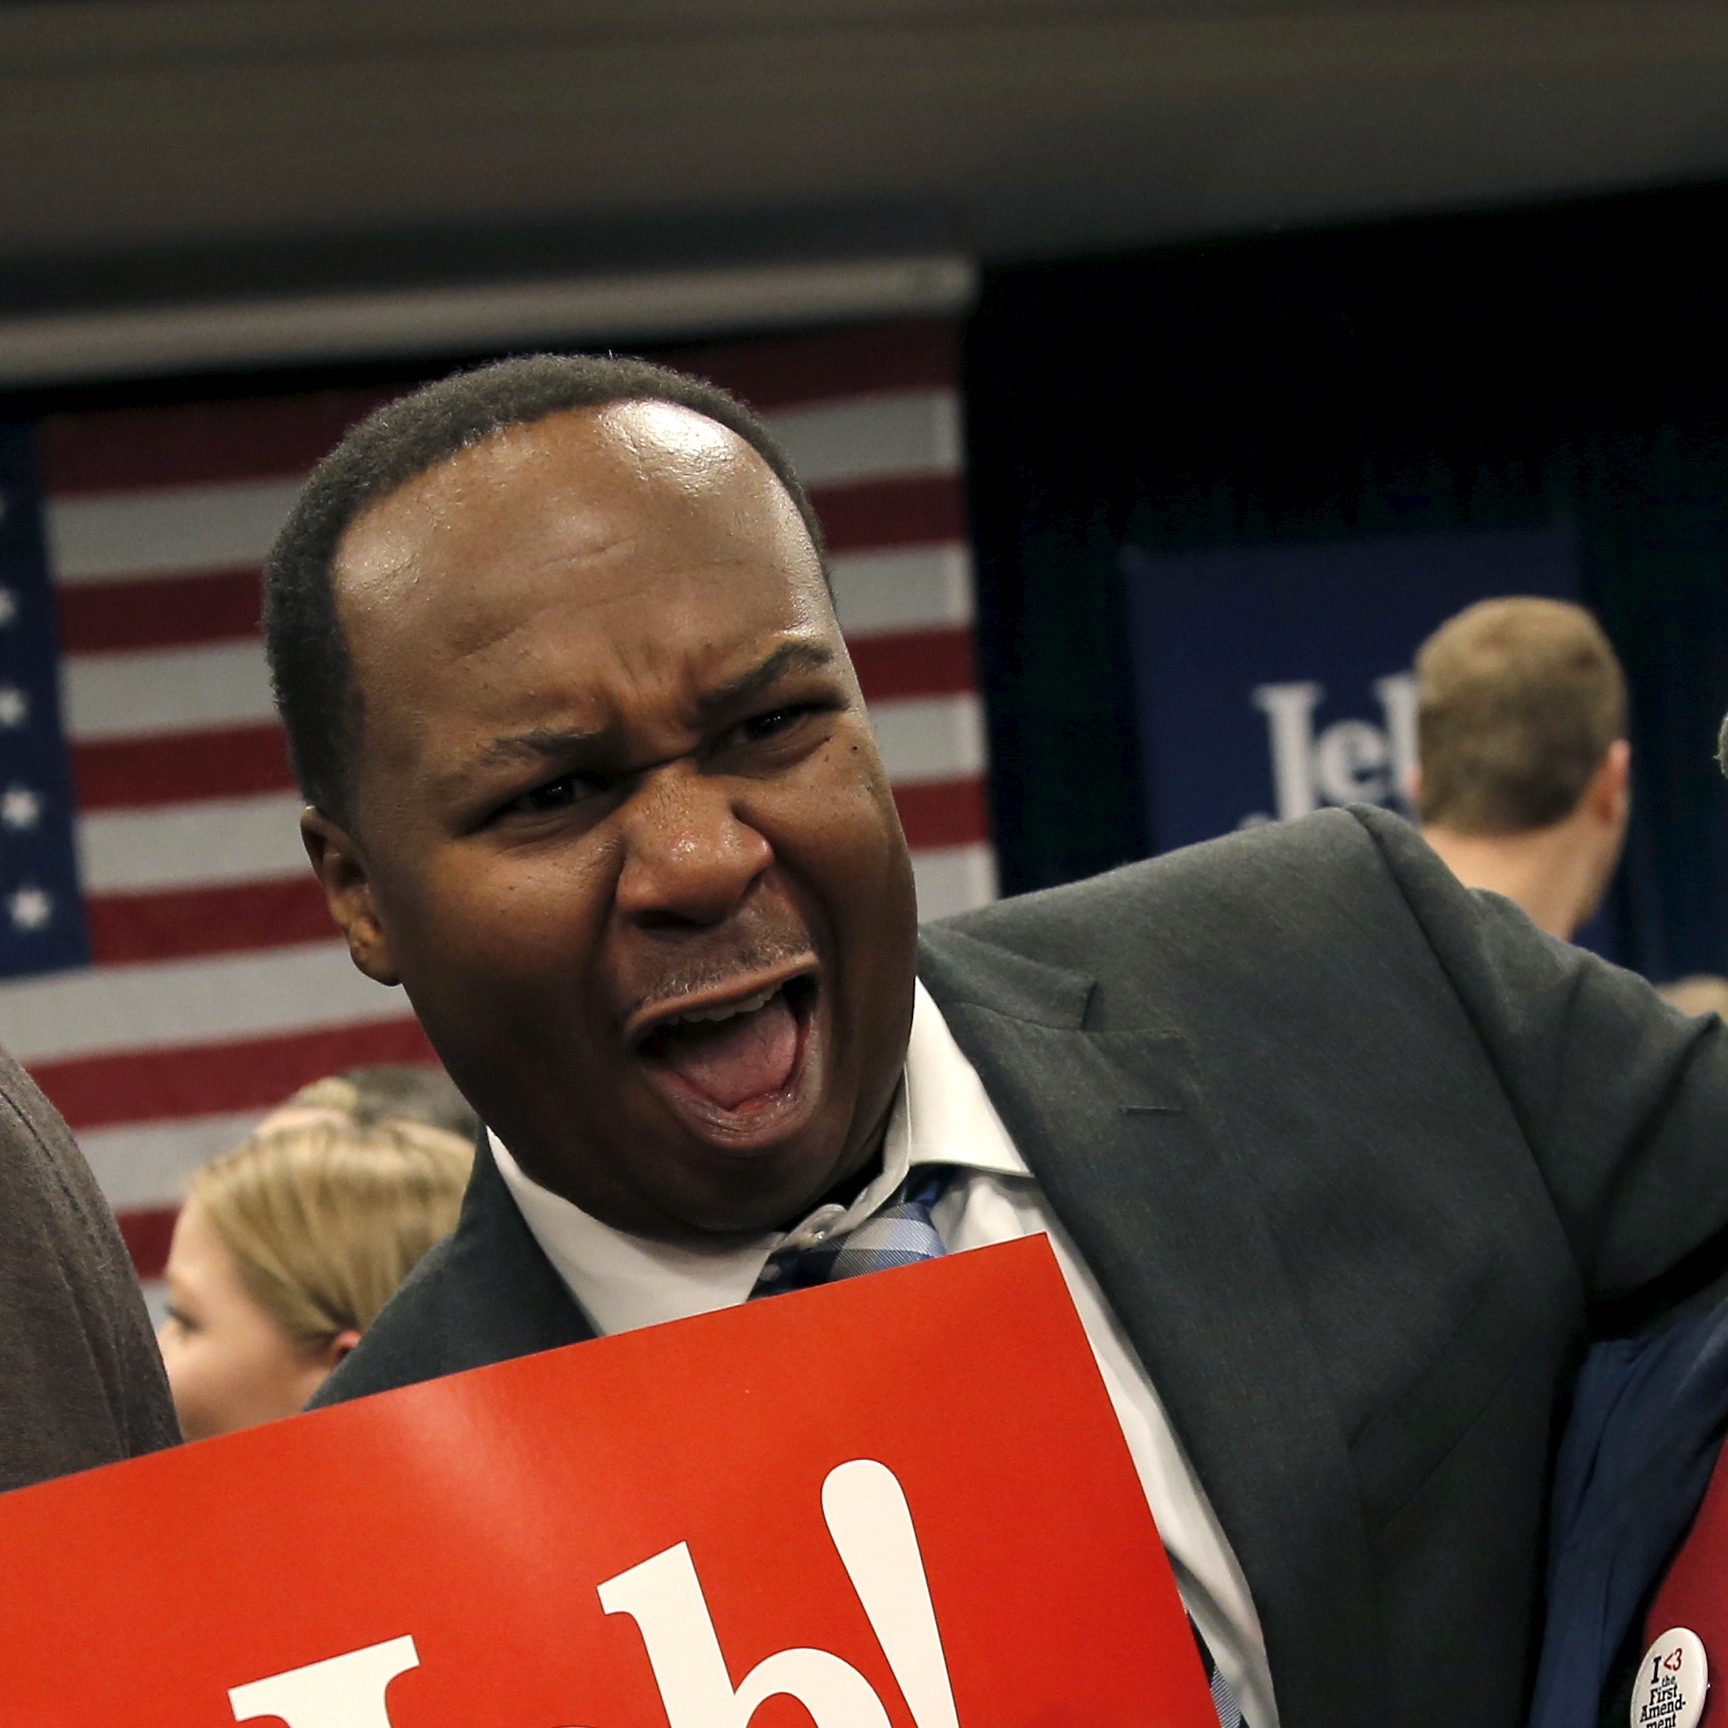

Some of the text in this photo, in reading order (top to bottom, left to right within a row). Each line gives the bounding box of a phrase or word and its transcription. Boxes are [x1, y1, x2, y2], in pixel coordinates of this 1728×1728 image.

[1650, 1655, 1662, 1685] I
[1661, 1674, 1677, 1689] the
[1639, 1693, 1687, 1723] Amend-
[1649, 1683, 1678, 1707] First
